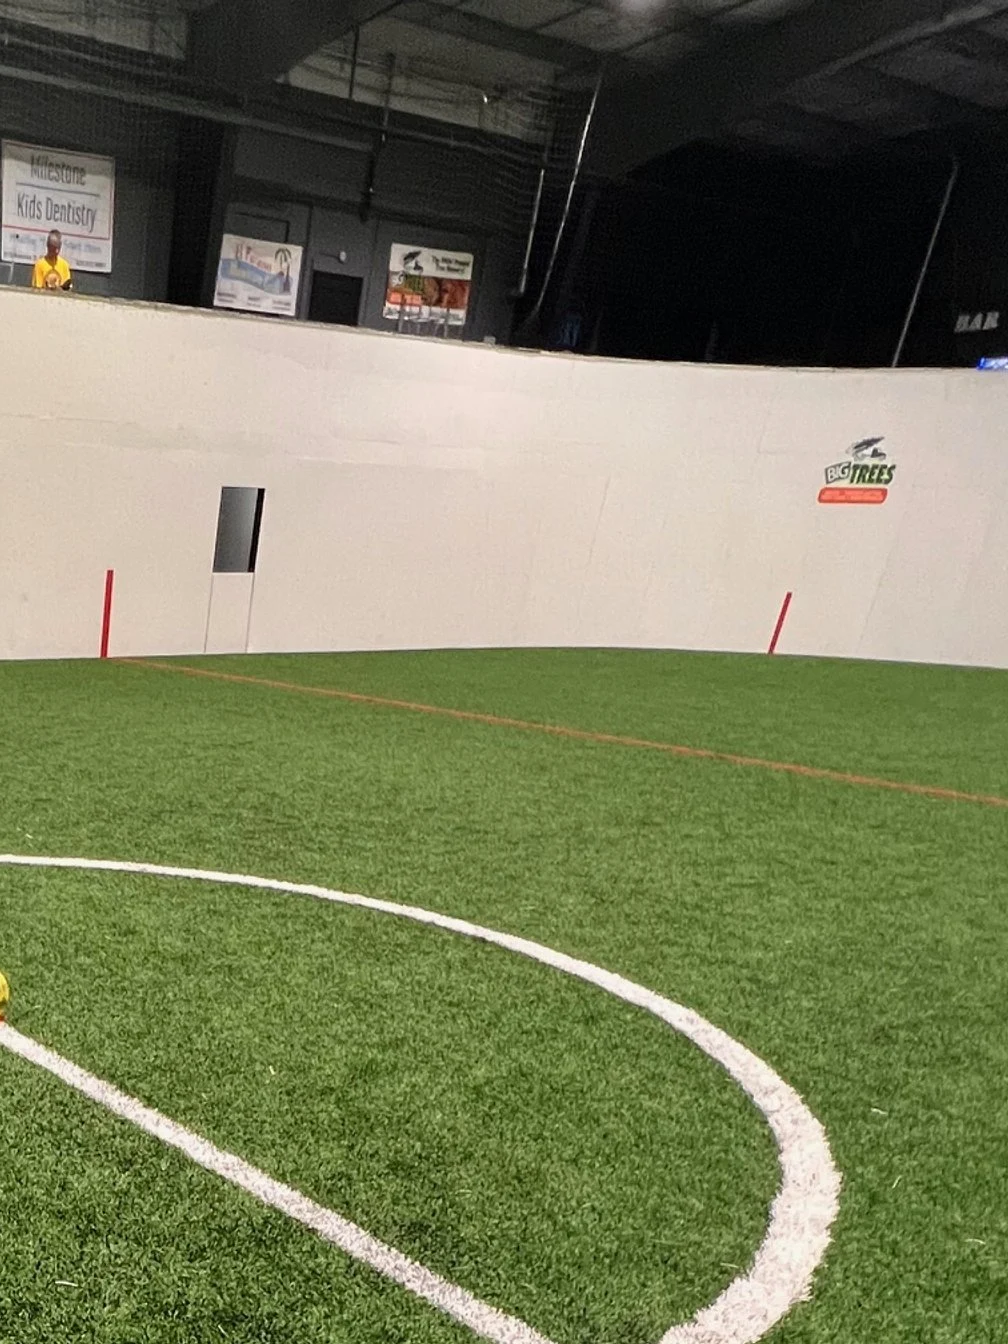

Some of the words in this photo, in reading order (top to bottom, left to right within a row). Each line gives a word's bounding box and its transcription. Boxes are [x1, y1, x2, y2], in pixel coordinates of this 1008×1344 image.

[30, 155, 88, 186] Milestone
[17, 192, 43, 221] Kids
[45, 197, 98, 233] Dentistry
[827, 463, 850, 483] BIG
[850, 464, 897, 485] TREES
